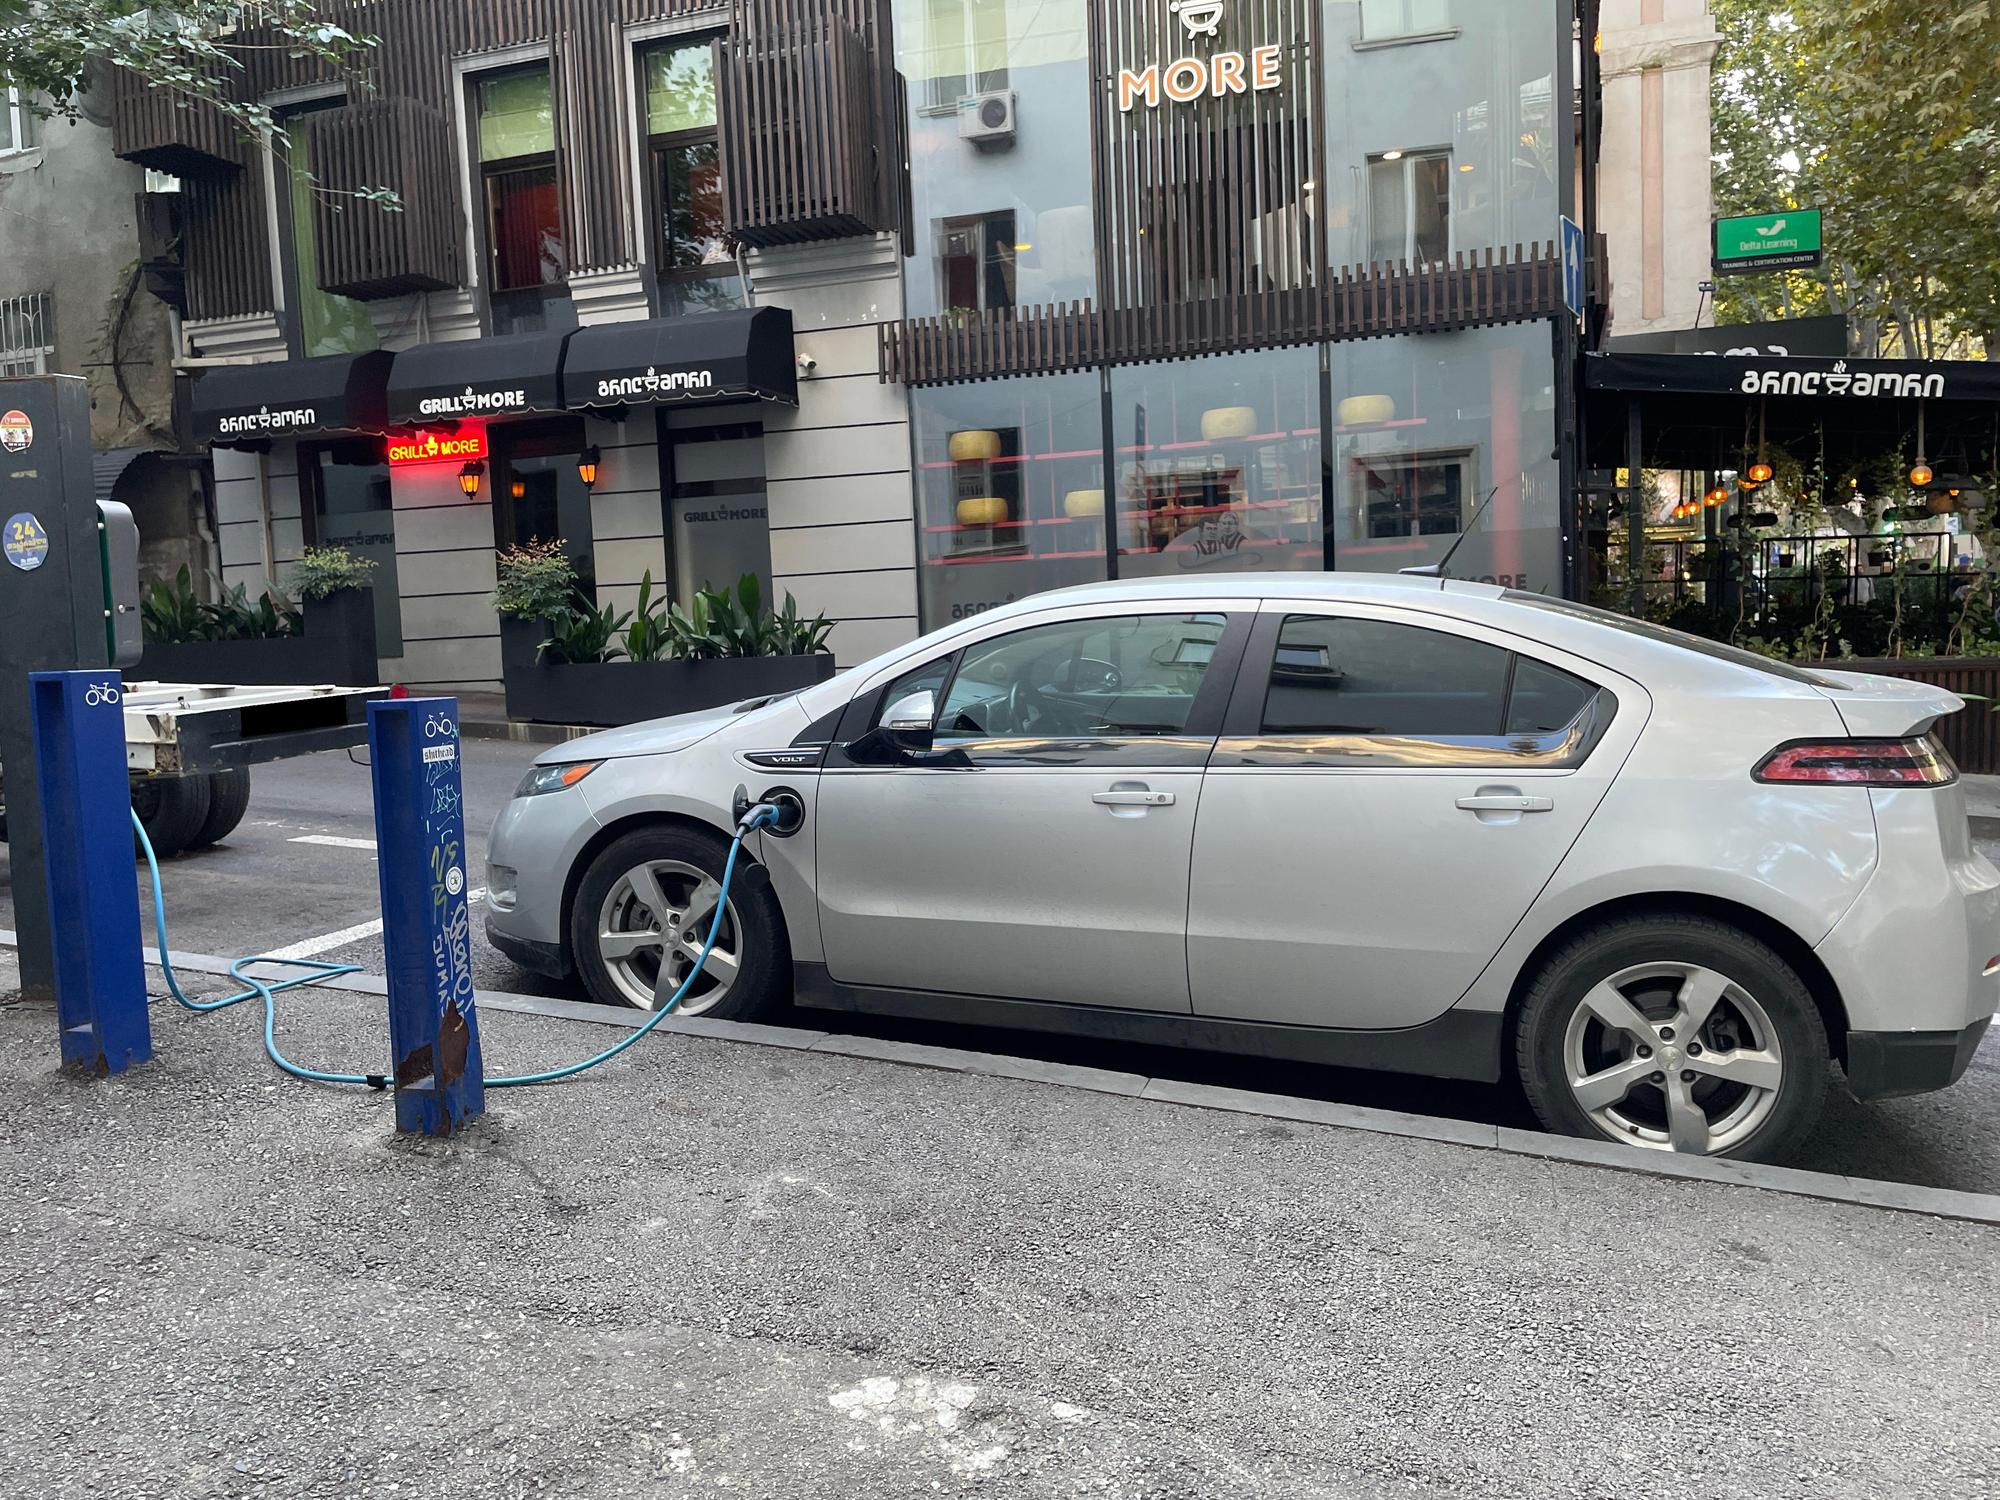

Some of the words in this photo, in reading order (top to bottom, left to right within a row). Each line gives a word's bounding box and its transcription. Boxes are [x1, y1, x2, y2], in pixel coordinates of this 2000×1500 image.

[1119, 44, 1281, 112] MORE
[1740, 240, 1761, 251] Delta
[1763, 238, 1798, 249] Learning
[1722, 260, 1748, 268] TRAINING
[1754, 257, 1793, 266] CERTIFICATION
[420, 397, 463, 414] GRILL
[477, 390, 525, 409] MORE
[389, 442, 428, 460] GRILL
[441, 439, 480, 455] MORE
[684, 511, 718, 523] GRILL
[730, 508, 768, 520] MORE
[12, 521, 36, 540] 24
